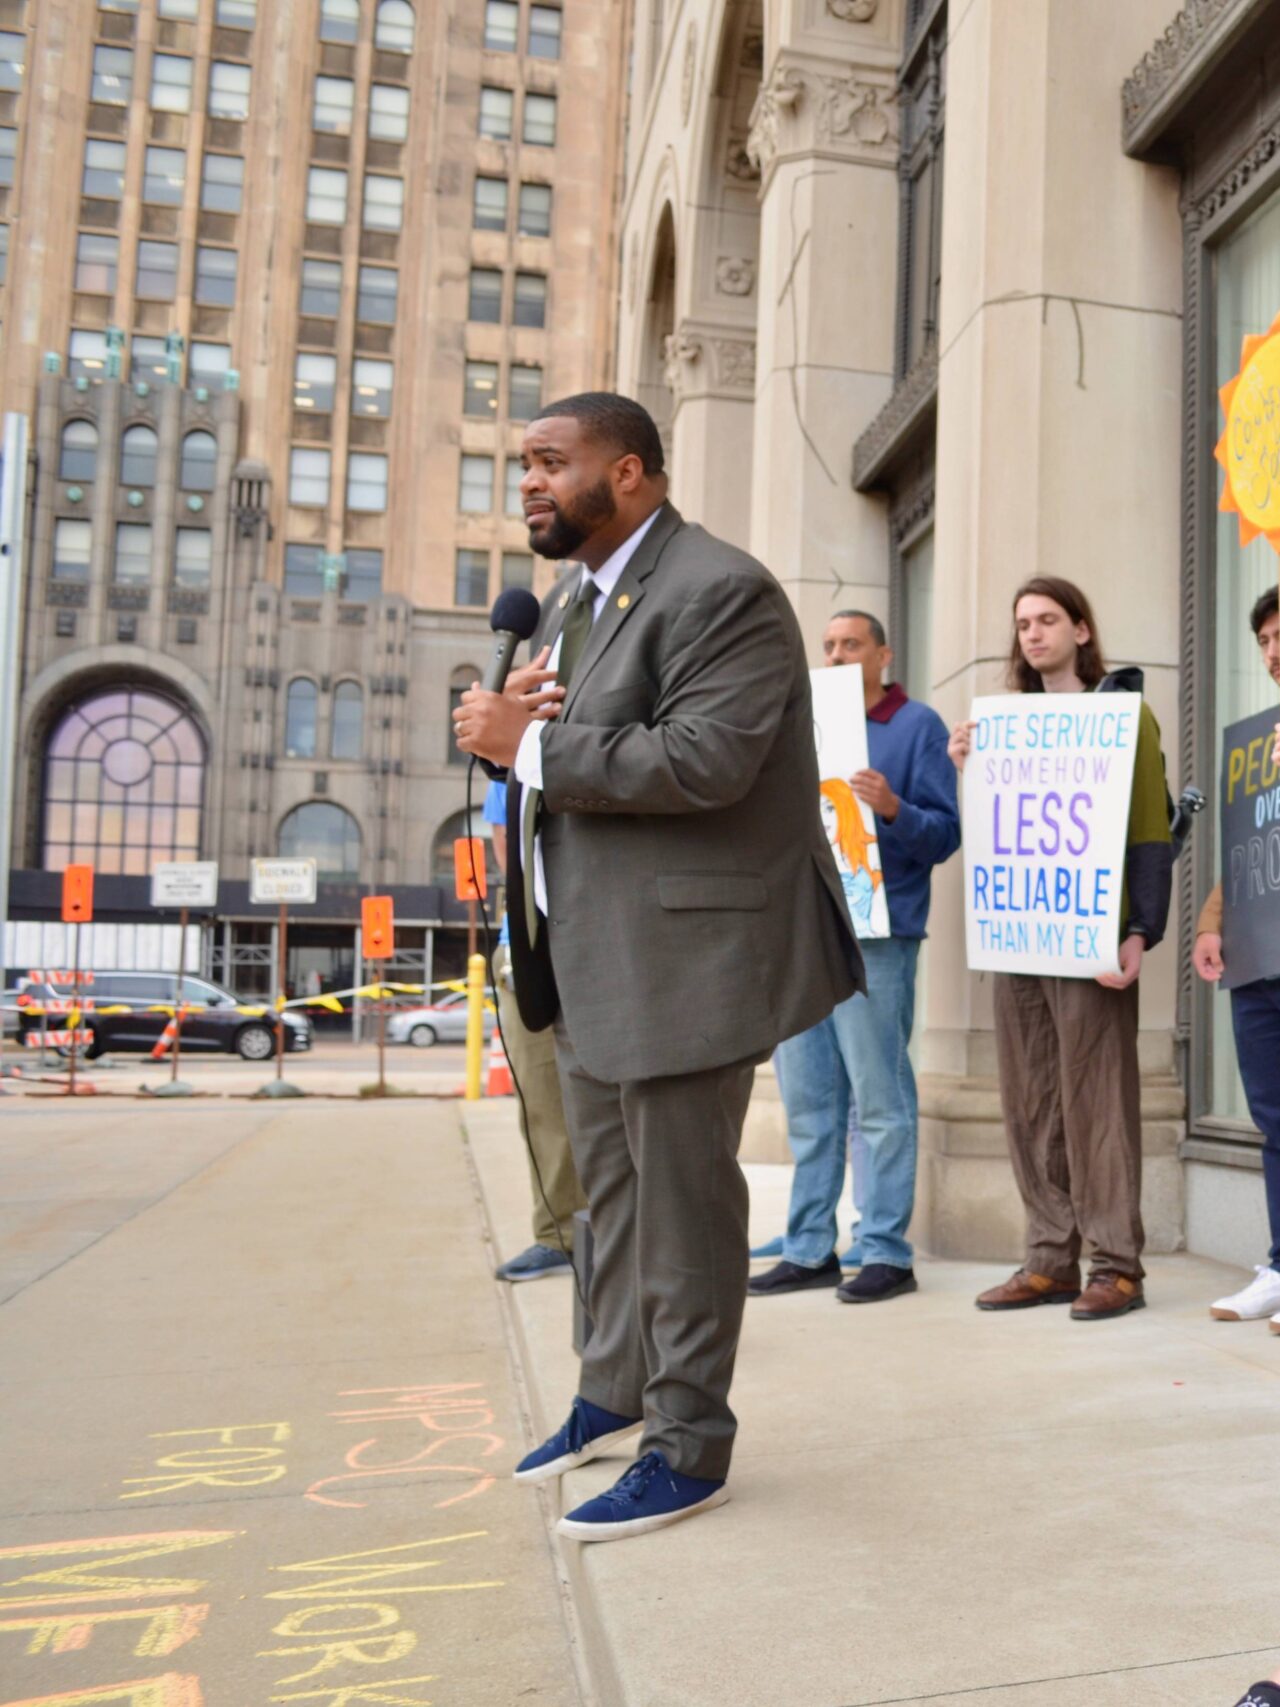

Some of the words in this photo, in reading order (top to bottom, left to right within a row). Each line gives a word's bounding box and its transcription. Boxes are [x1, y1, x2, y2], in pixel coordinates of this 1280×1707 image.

[976, 714, 1019, 751] DTE
[1025, 711, 1132, 749] SERVICE
[985, 755, 1111, 786] SOMEHOW
[993, 791, 1093, 857] LESS
[973, 865, 1111, 917] RELIABLE
[977, 919, 1029, 955] THAN
[1037, 922, 1066, 957] MY
[1074, 924, 1100, 960] EX
[118, 1420, 292, 1500] FOR
[304, 1382, 505, 1509] MPSC
